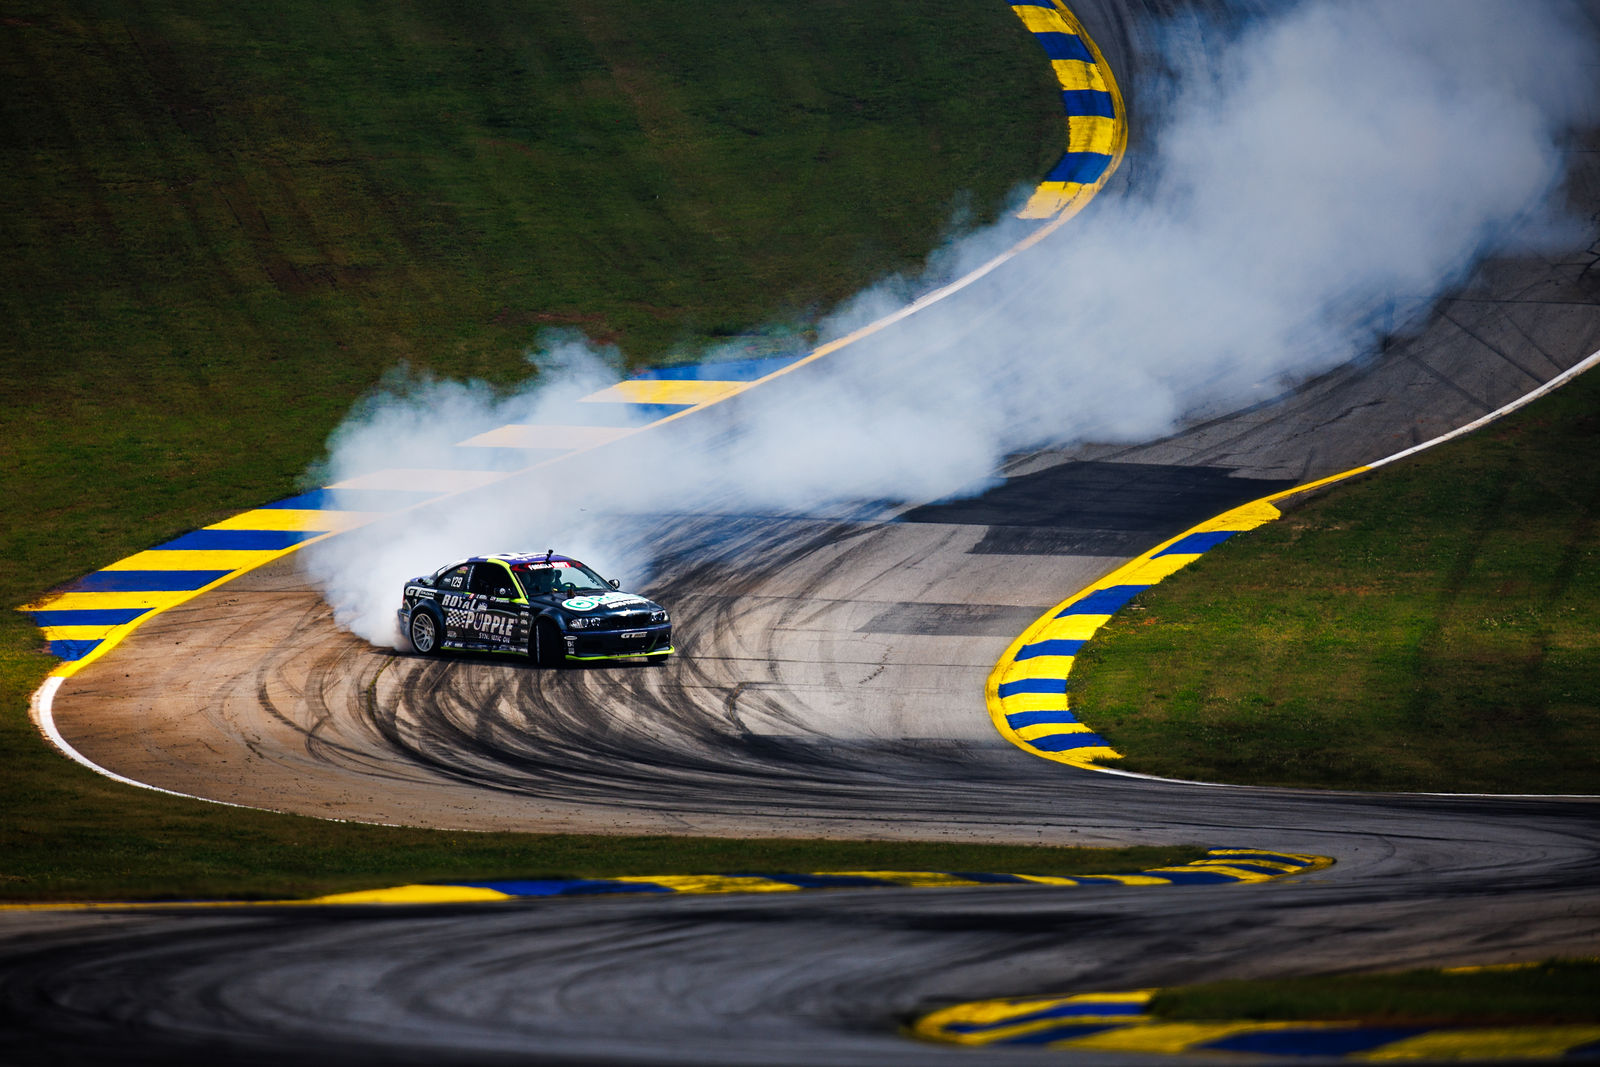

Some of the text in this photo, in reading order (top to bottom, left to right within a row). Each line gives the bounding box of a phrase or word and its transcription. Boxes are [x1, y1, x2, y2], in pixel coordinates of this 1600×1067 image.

[451, 576, 463, 588] 129
[405, 586, 421, 597] GT
[442, 594, 476, 611] ROYAL
[465, 610, 514, 636] PURPLE
